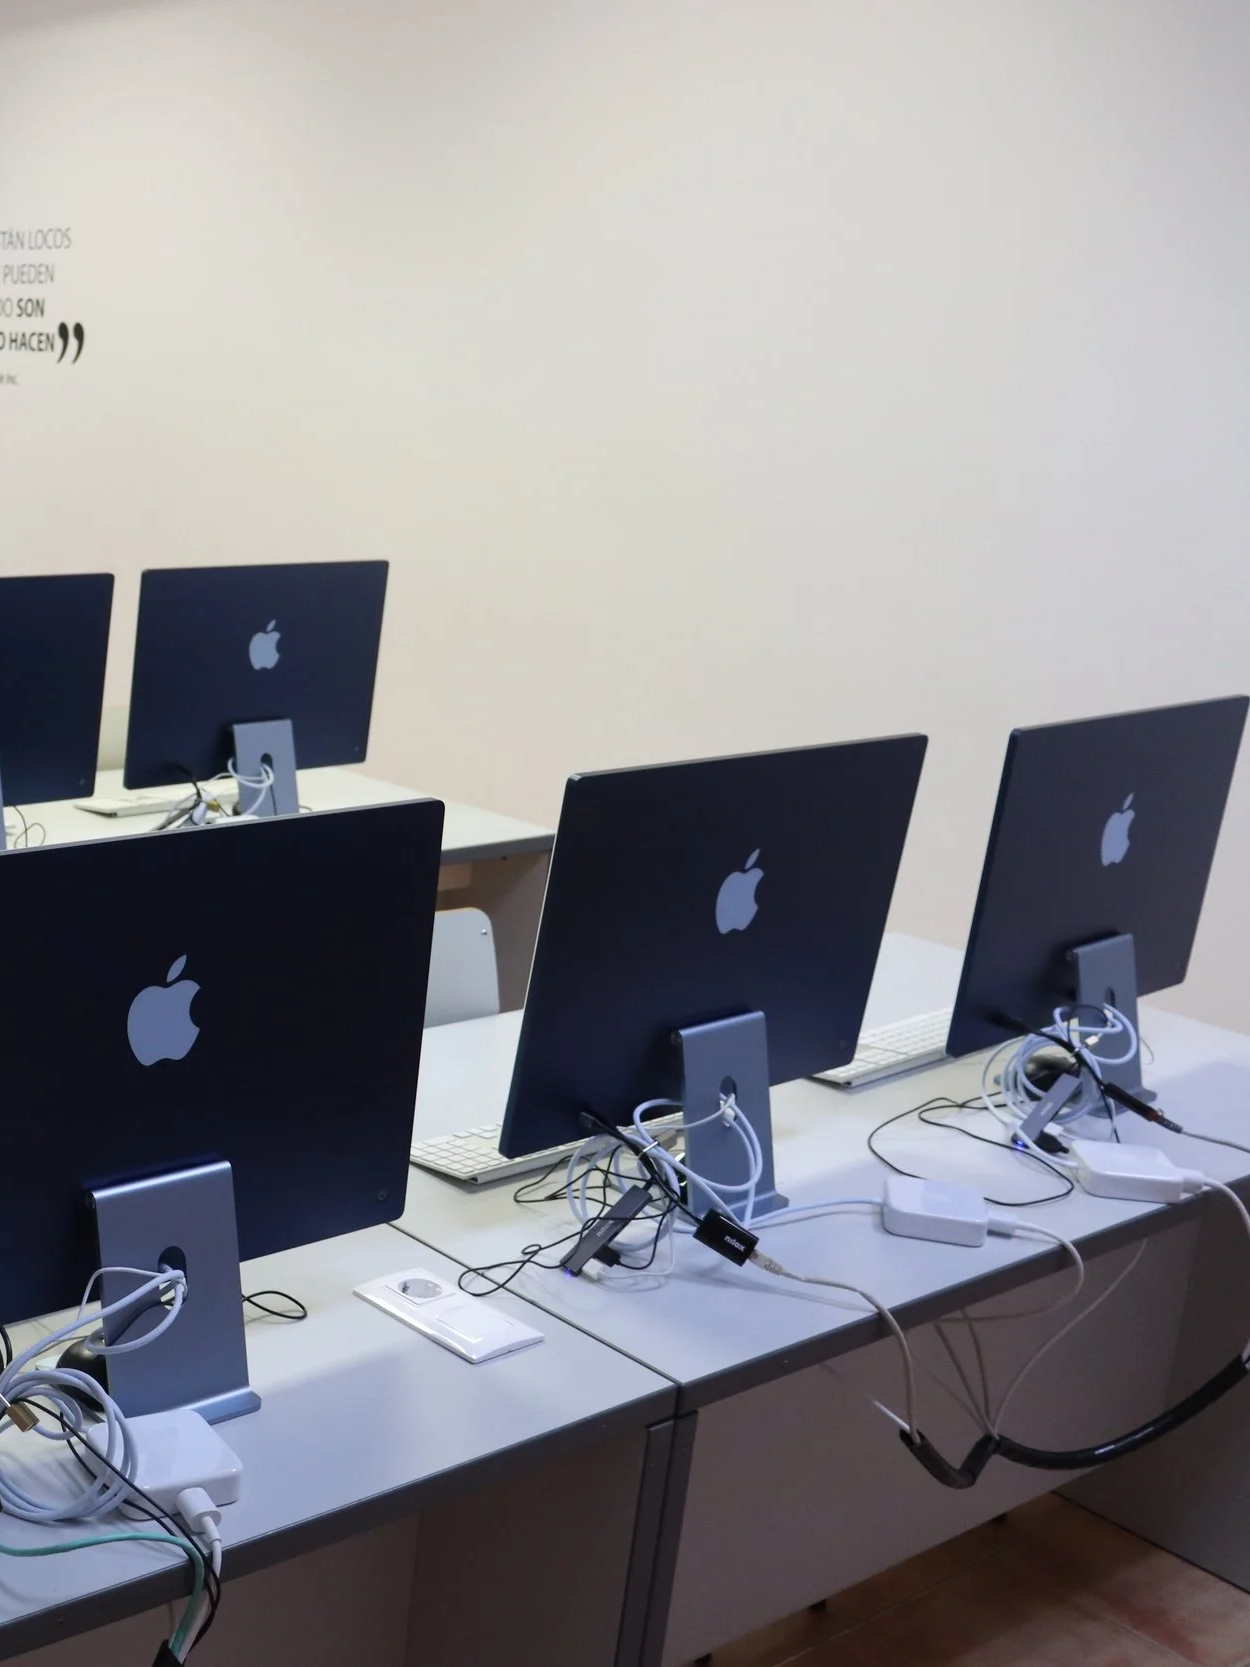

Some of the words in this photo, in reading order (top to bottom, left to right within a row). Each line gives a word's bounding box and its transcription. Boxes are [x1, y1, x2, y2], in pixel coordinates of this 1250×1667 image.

[28, 227, 72, 250] LOCOS
[2, 263, 55, 284] PUEDEN
[16, 297, 45, 318] SON
[9, 331, 55, 353] HACEN
[724, 1235, 746, 1252] nilox
